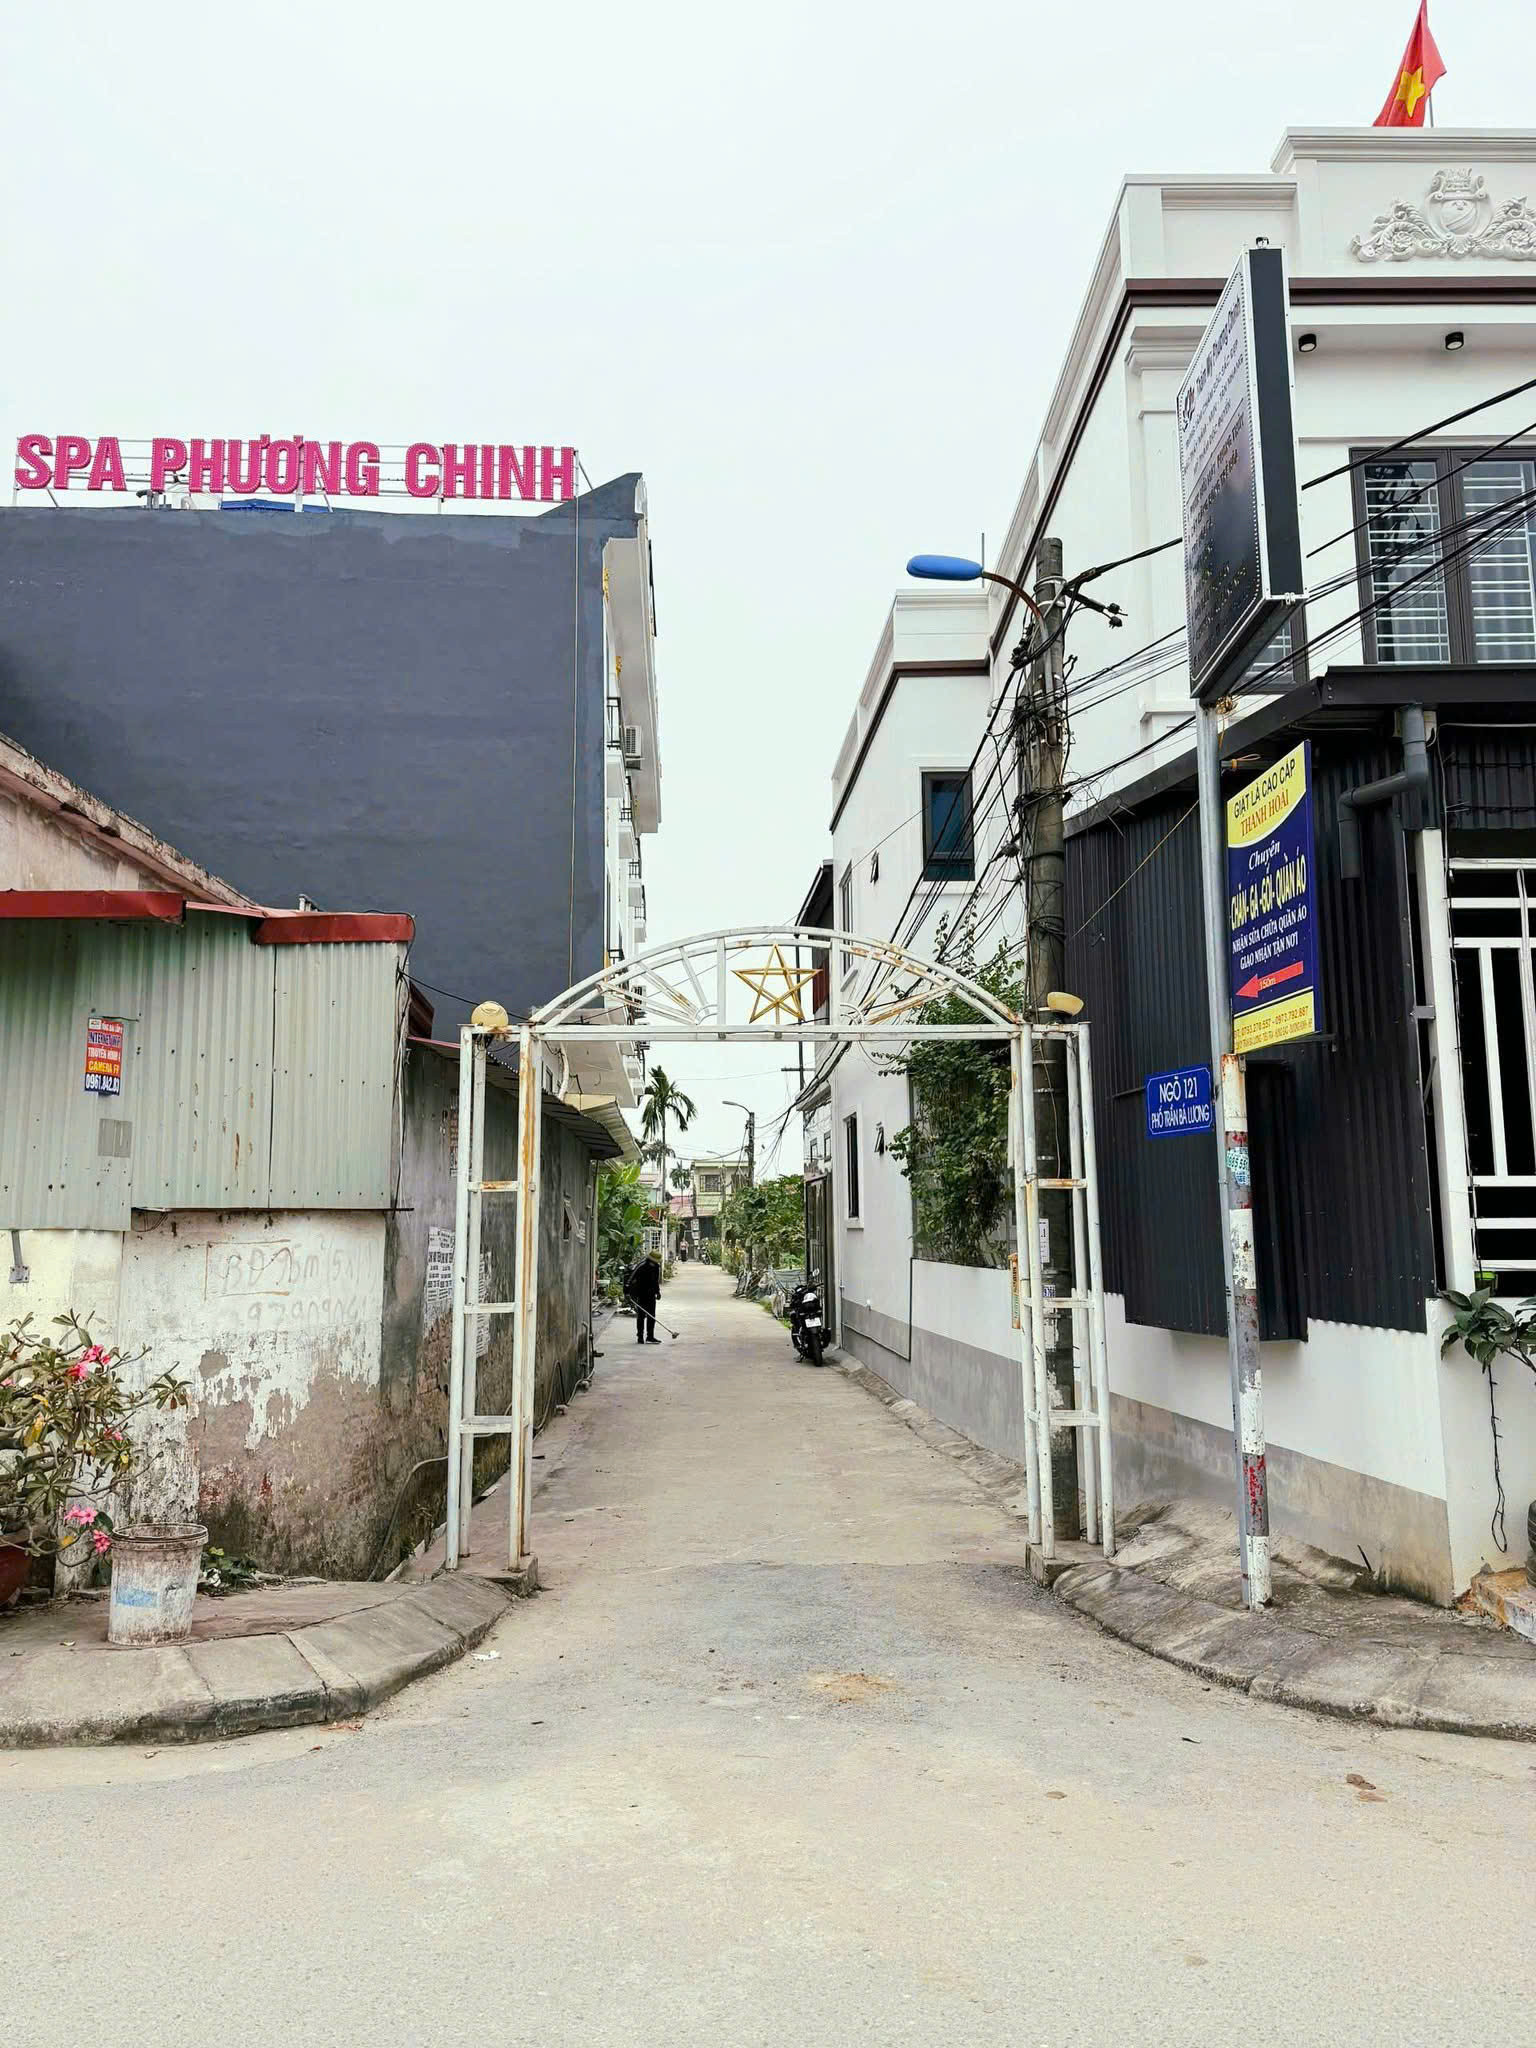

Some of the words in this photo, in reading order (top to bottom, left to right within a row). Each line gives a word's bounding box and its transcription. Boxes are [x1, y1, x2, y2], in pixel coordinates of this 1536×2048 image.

[15, 434, 127, 491] SPA
[151, 434, 381, 497] PHƯƠNG
[405, 442, 574, 502] CHINH
[1234, 794, 1249, 819] GIẶT
[1251, 783, 1260, 806] LÀ
[1261, 772, 1277, 798] CAO
[1279, 756, 1295, 784] CẤP
[1241, 806, 1266, 836] THANH
[1249, 839, 1280, 871] Chuyên
[1296, 846, 1306, 897] ÁO
[1296, 905, 1306, 923] ÁO
[1255, 944, 1271, 966] NHẬN
[89, 1061, 112, 1073] CAMERA
[1159, 1076, 1181, 1103] NGÕ
[1184, 1077, 1198, 1099] 121
[1152, 1105, 1163, 1128] PHỐ
[1164, 1104, 1178, 1127] TRẦN
[1179, 1103, 1187, 1125] BÁ
